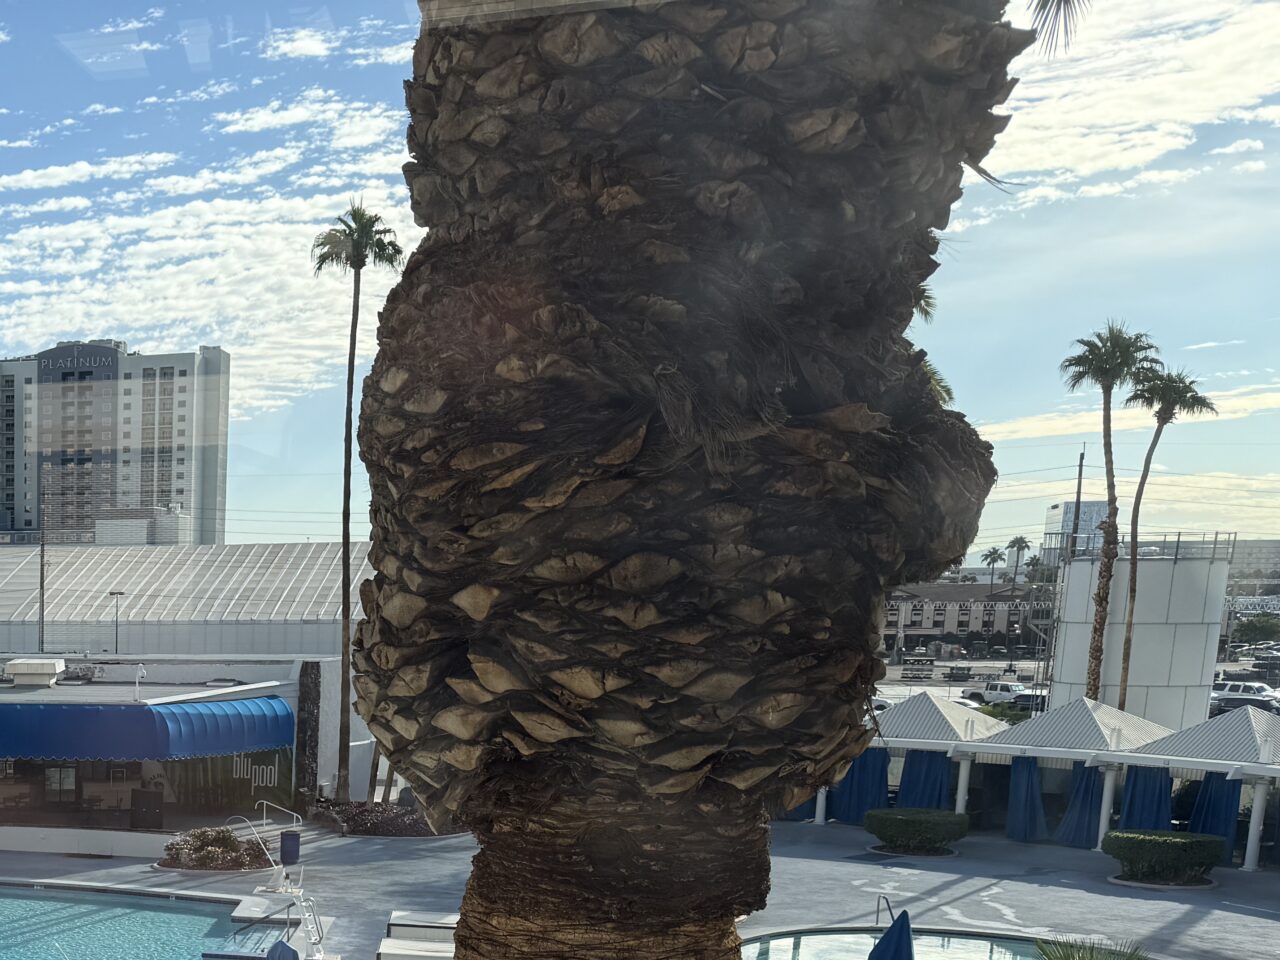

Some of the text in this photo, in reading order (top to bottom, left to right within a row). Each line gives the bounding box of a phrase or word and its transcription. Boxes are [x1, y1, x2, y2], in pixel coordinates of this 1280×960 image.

[41, 356, 113, 369] PLATINUM
[232, 753, 252, 779] blu
[251, 753, 279, 796] pool
